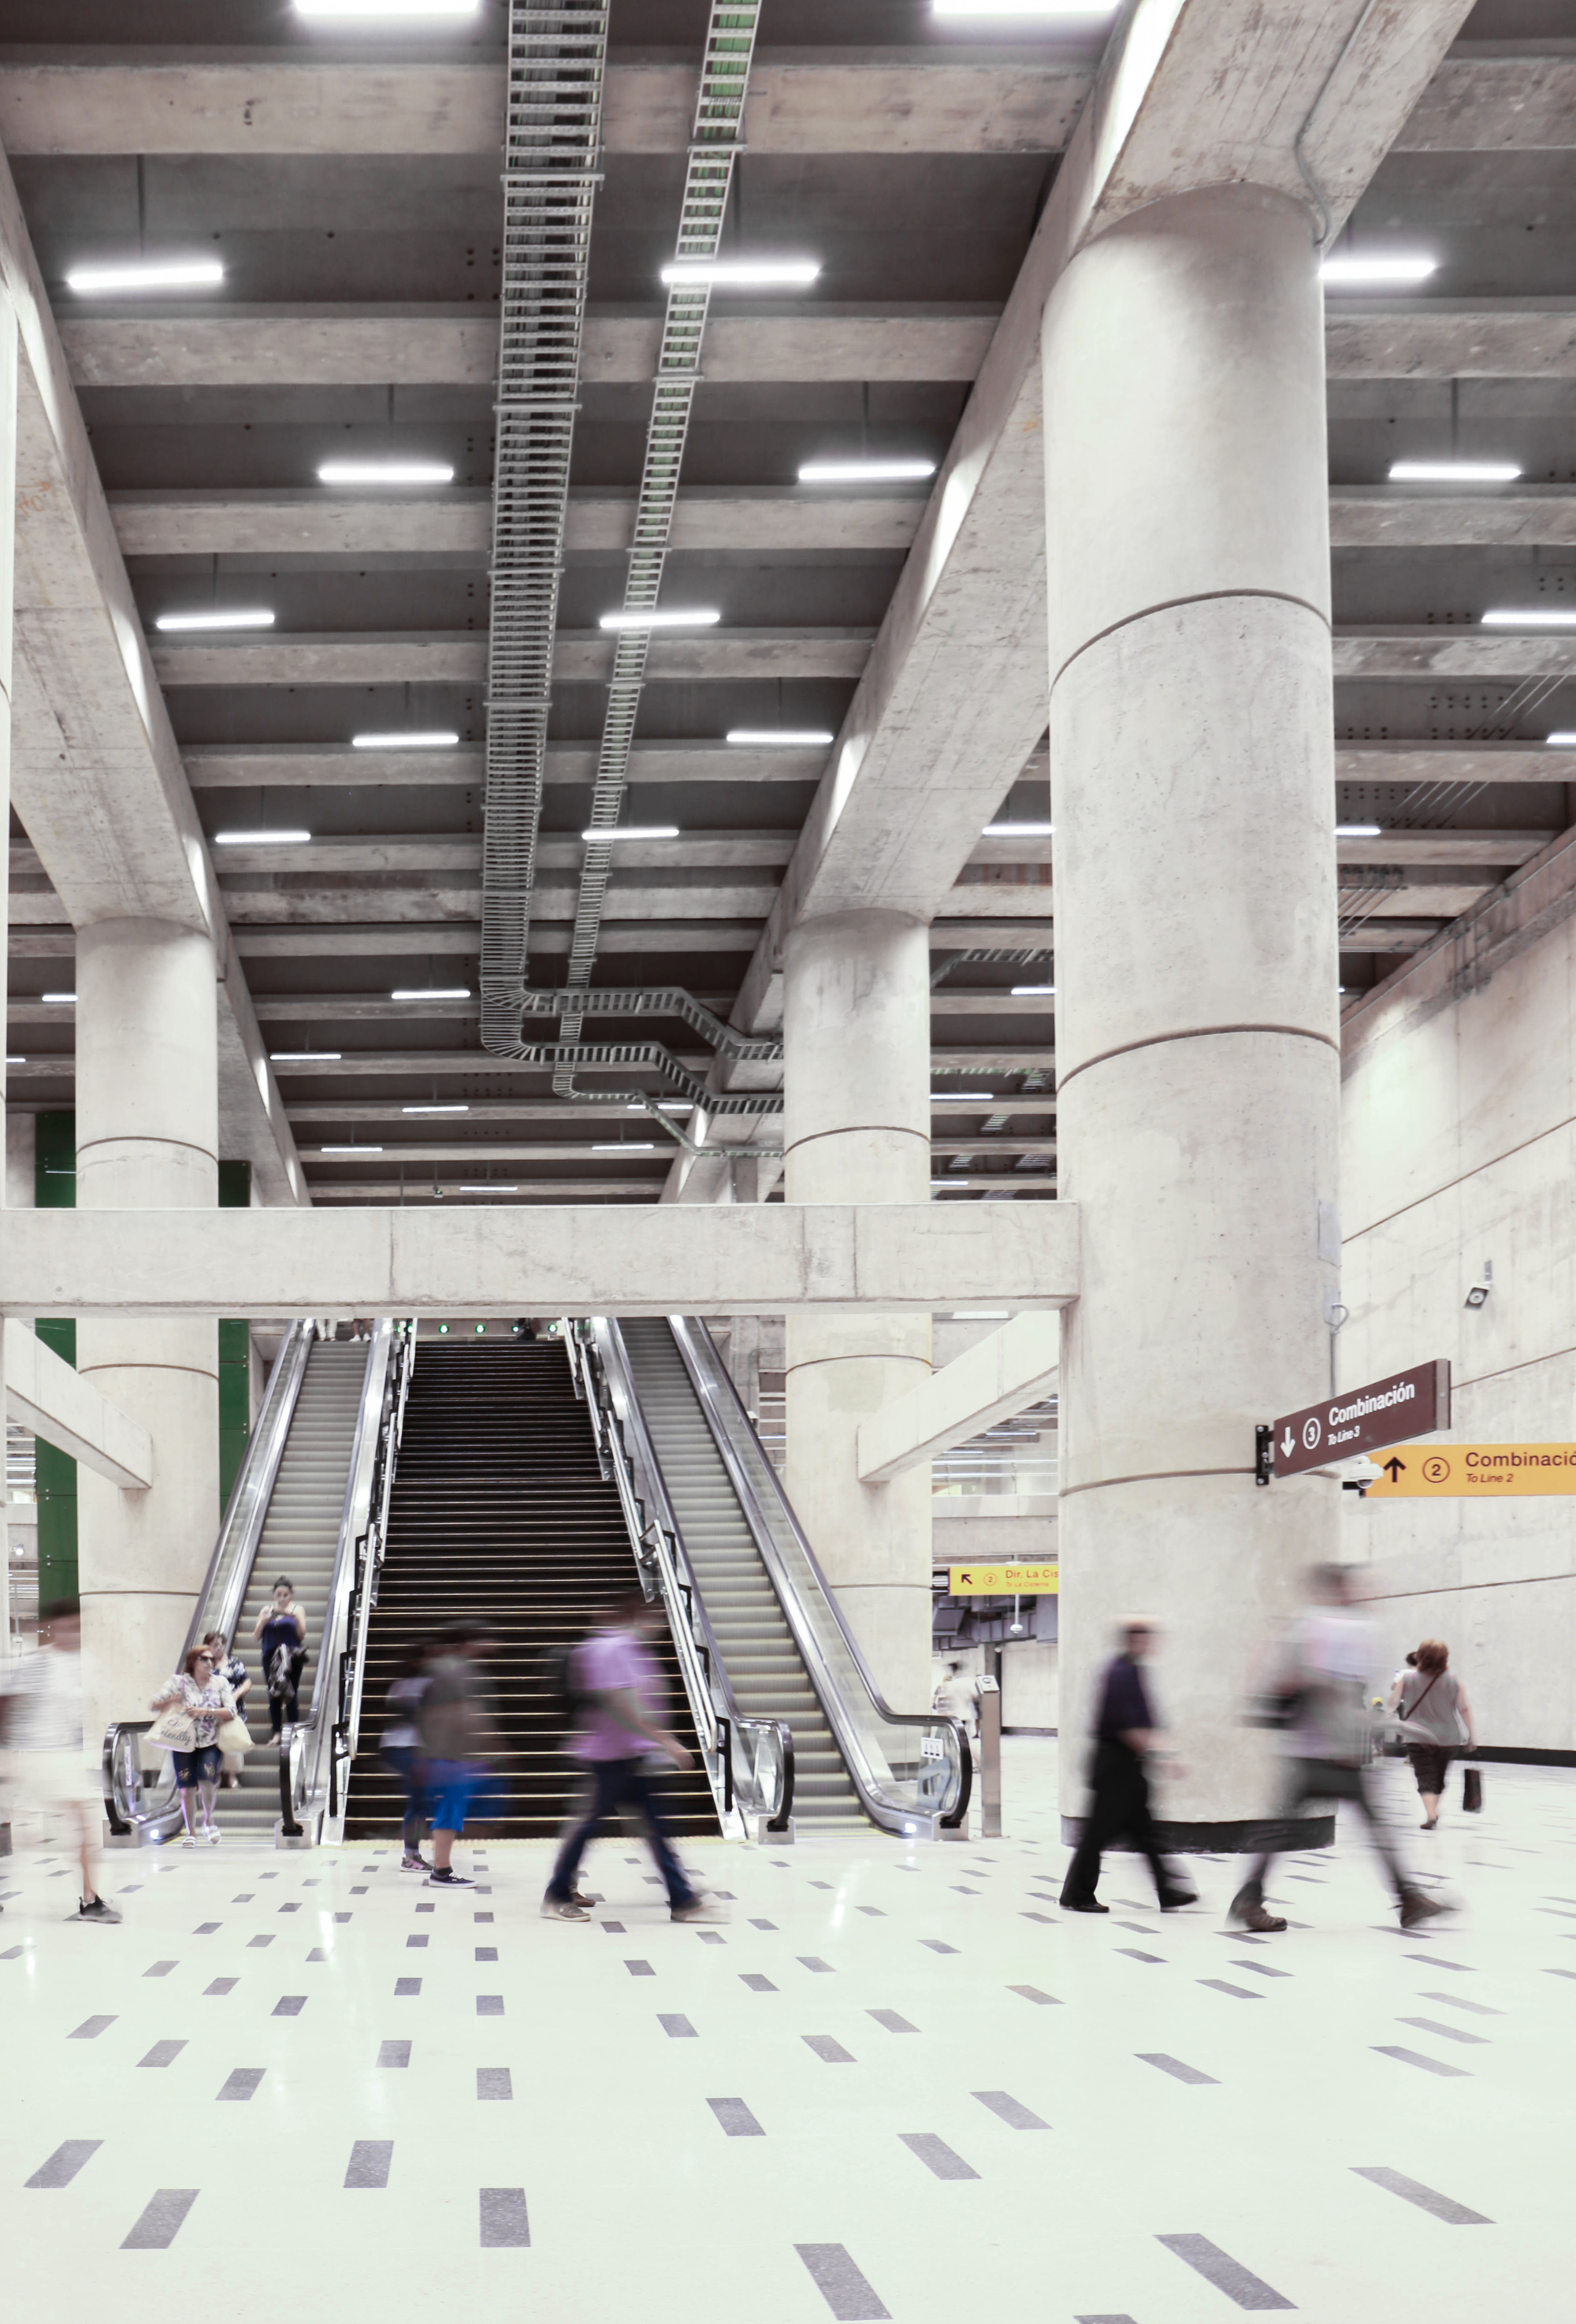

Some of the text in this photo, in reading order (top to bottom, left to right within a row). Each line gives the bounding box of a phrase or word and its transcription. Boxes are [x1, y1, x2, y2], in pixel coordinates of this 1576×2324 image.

[1329, 1381, 1415, 1426] Combinación
[1327, 1425, 1361, 1446] To Line 3
[1466, 1473, 1514, 1483] To Line 2
[1005, 1569, 1058, 1578] Dir. La Cis
